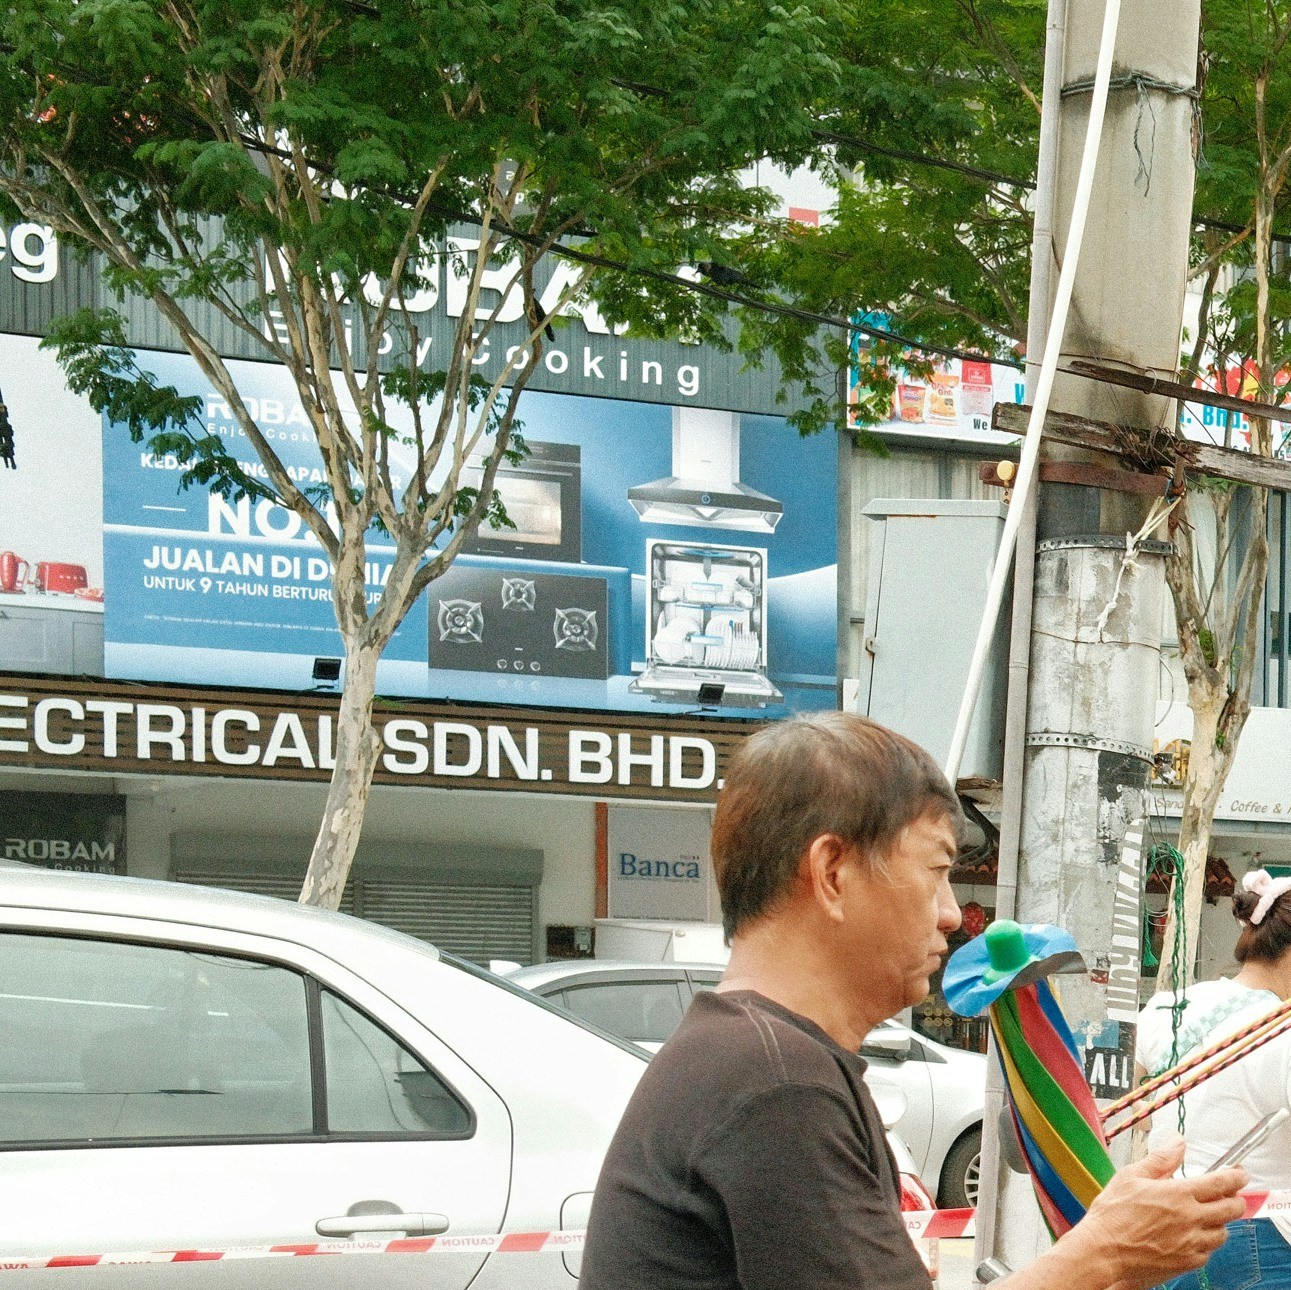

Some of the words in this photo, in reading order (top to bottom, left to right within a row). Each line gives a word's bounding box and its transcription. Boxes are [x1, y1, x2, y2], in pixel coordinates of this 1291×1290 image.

[973, 418, 988, 431] We
[144, 547, 263, 578] JUALAN
[271, 555, 301, 580] DI
[144, 575, 196, 592] UNTUK
[200, 576, 212, 594] 9
[216, 580, 268, 597] TAHUN
[382, 720, 552, 781] SDN.
[567, 730, 724, 791] BHD.
[1231, 800, 1268, 815] Coffee
[1273, 801, 1281, 814] &
[5, 838, 115, 860] ROBAM
[619, 852, 700, 879] Banca
